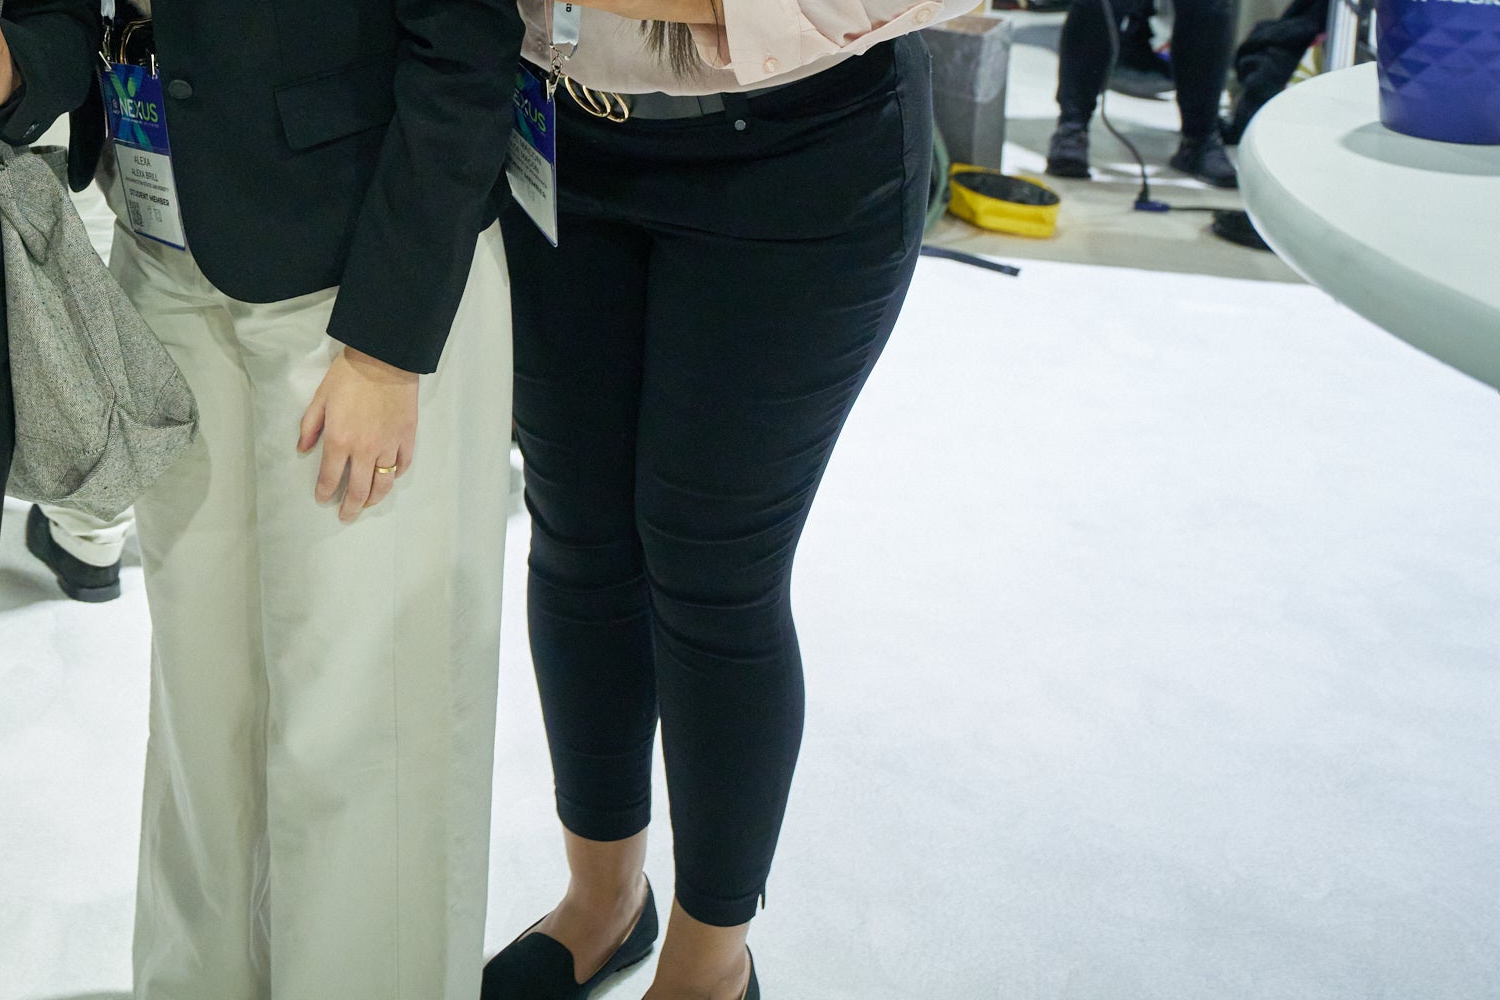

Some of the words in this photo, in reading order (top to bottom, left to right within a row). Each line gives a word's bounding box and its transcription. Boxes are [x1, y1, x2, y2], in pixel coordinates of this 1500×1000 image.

[119, 98, 159, 123] NEXUS
[512, 87, 547, 133] EXUS
[133, 155, 151, 167] ALEXA
[128, 188, 148, 200] STUDENT
[149, 194, 170, 206] MEMBER
